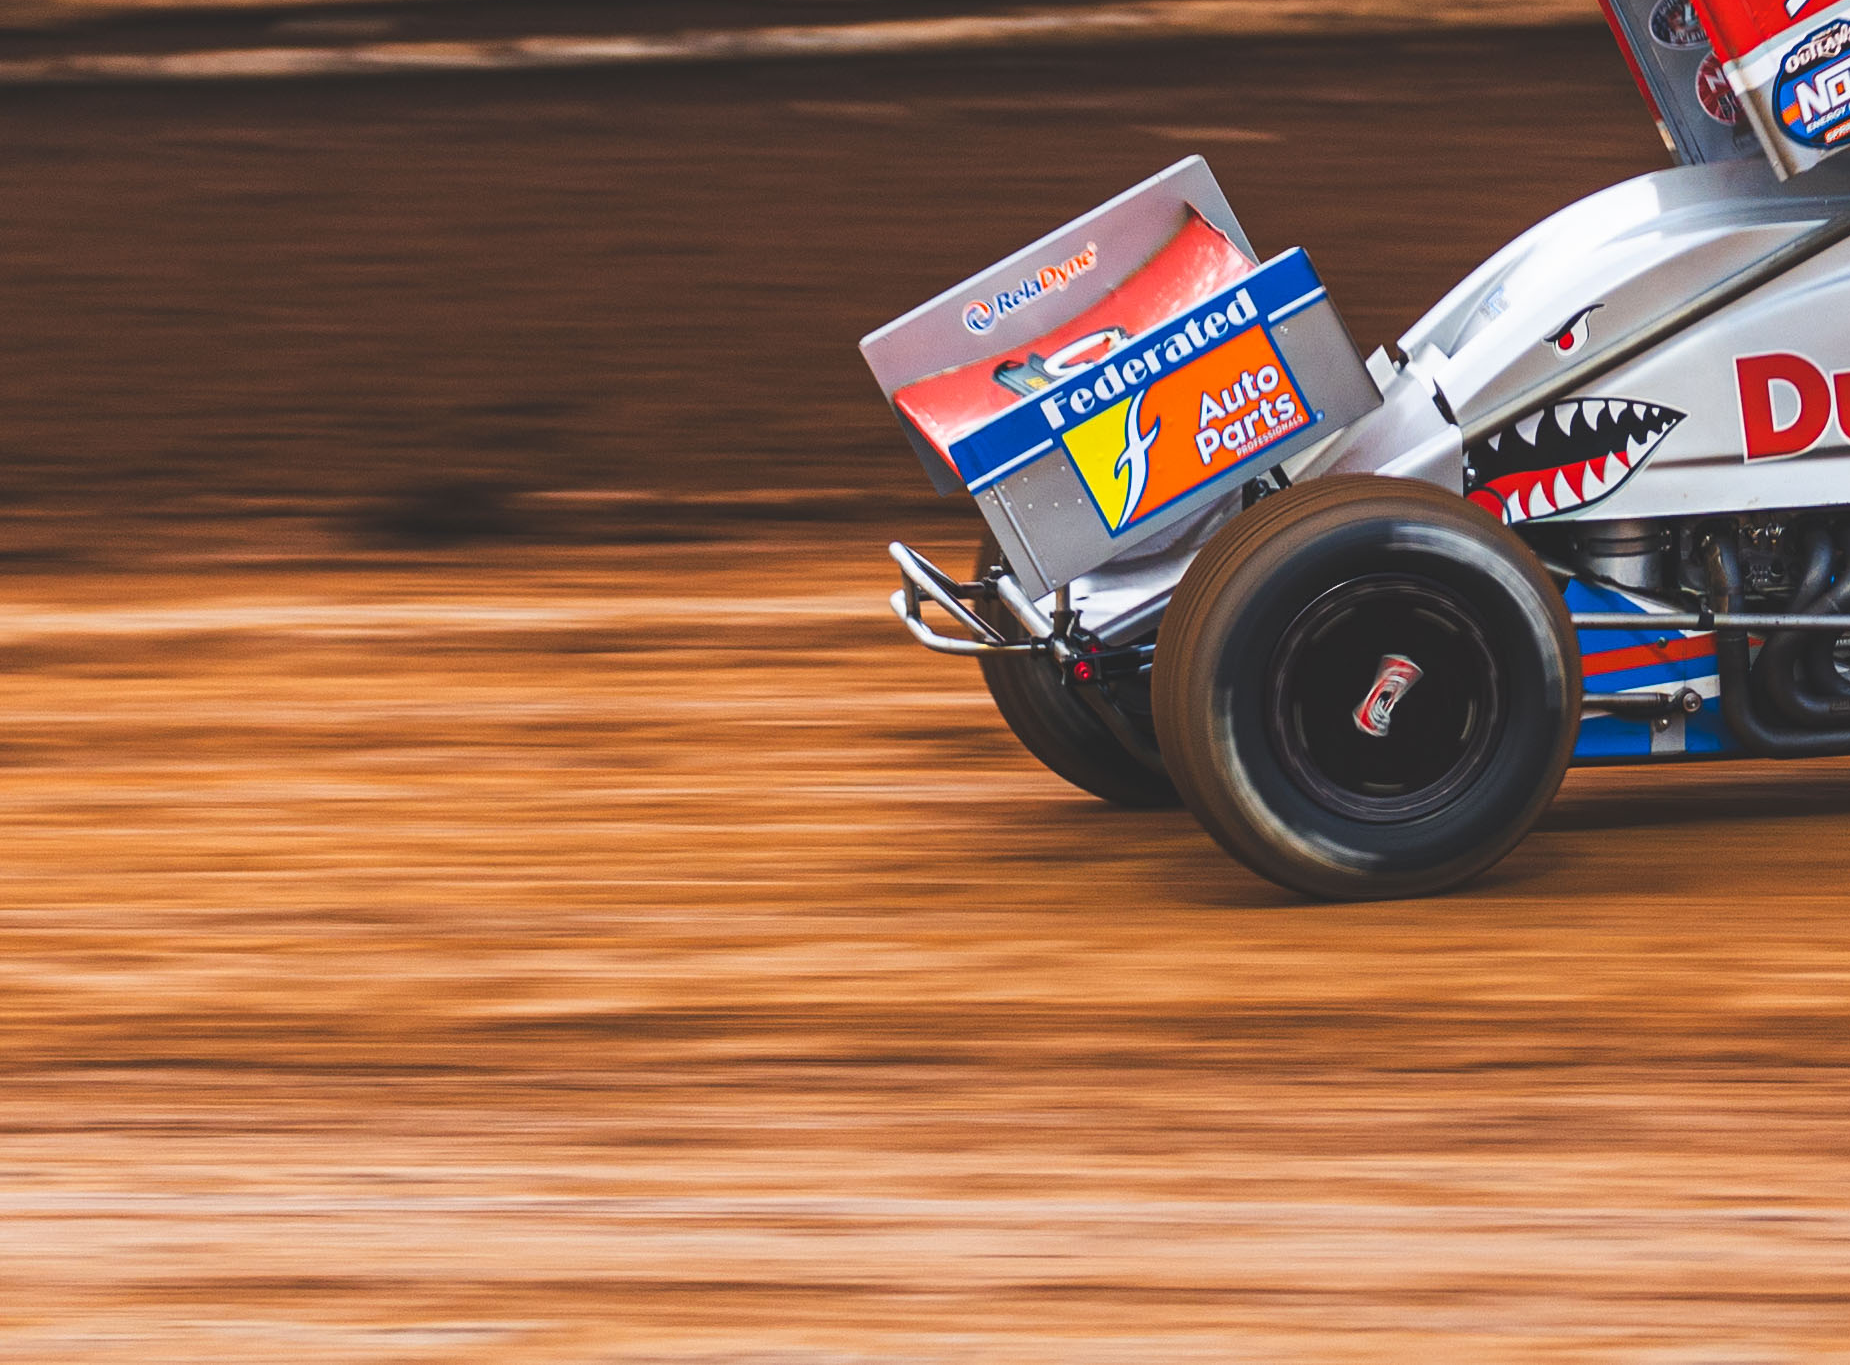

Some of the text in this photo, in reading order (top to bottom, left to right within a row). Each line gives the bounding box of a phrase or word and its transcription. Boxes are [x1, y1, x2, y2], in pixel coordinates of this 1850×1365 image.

[1806, 105, 1846, 133] ENERGY
[994, 248, 1096, 316] RelaDyne
[1040, 288, 1258, 430] Federated
[1195, 393, 1296, 466] Parts
[1200, 365, 1279, 429] Auto
[1236, 414, 1304, 457] PROFESSIONALS
